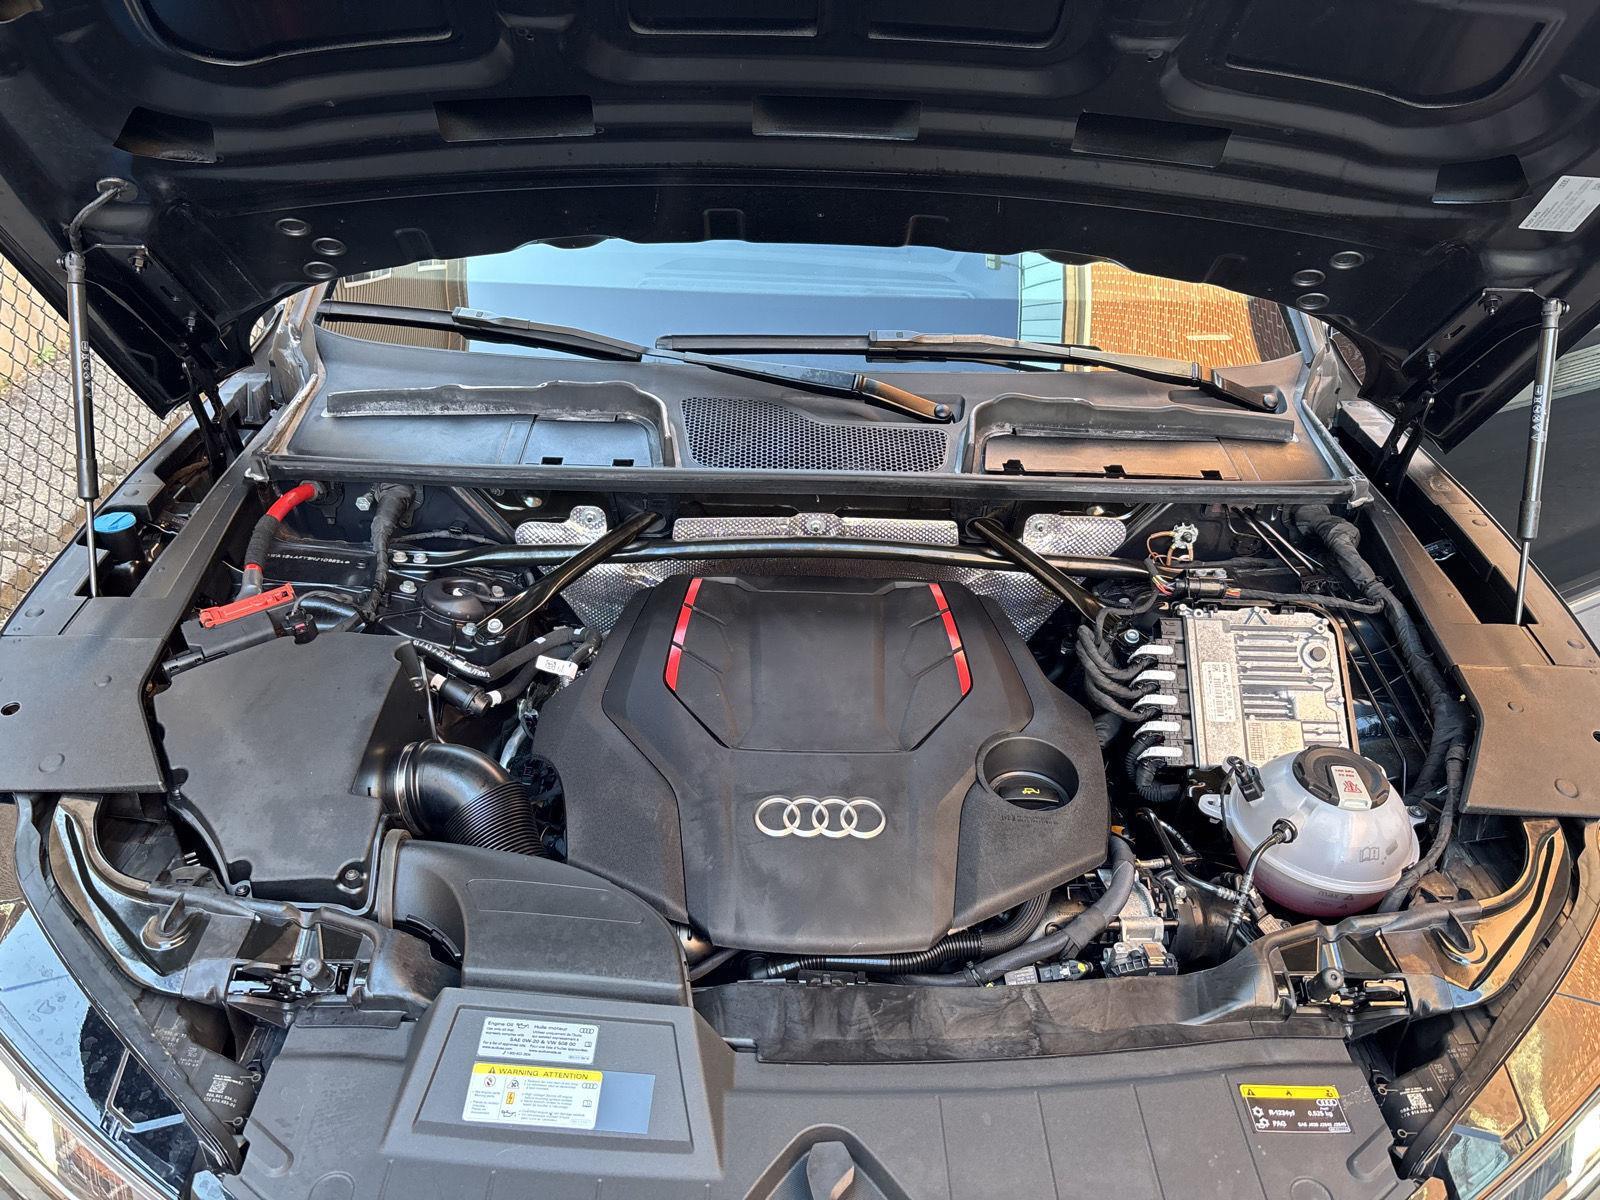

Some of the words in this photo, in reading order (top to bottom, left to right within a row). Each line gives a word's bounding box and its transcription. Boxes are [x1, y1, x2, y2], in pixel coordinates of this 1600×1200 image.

[1318, 890, 1340, 898] max
[499, 1068, 539, 1076] WARNING
[543, 1071, 589, 1080] ATTENTION
